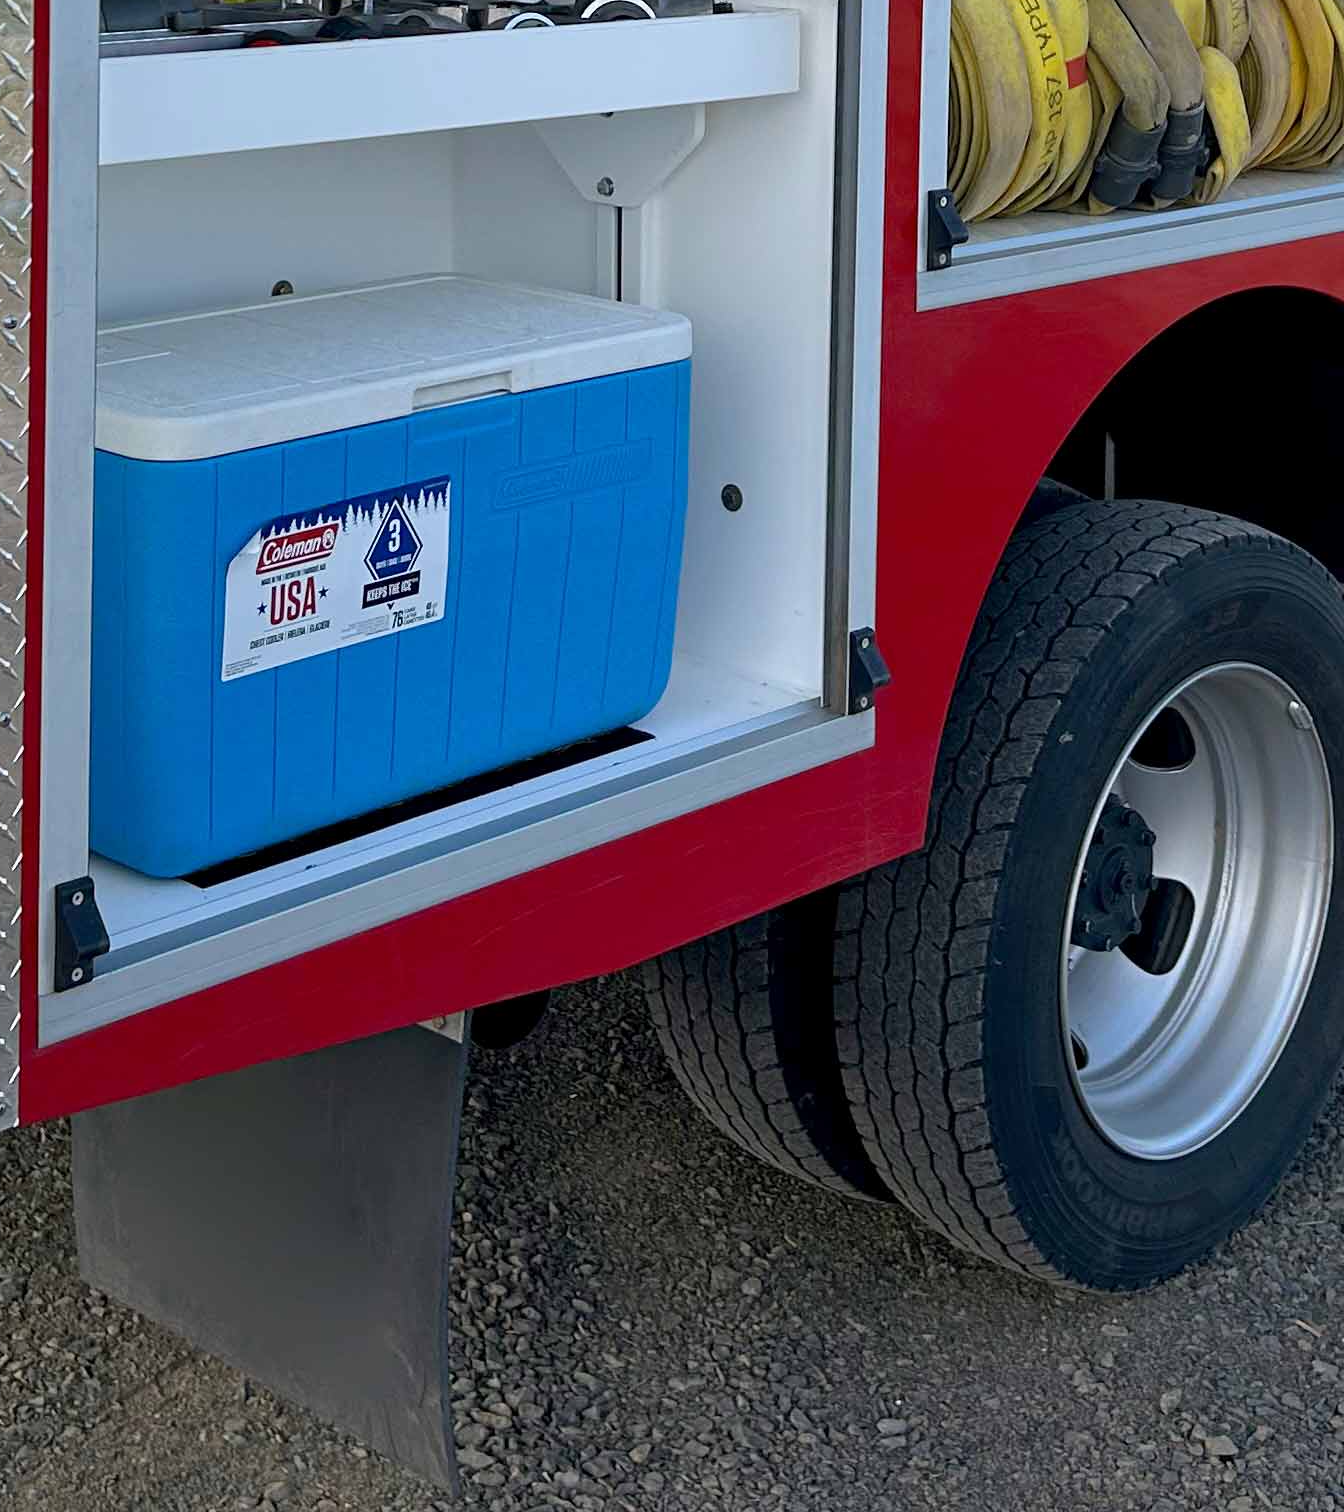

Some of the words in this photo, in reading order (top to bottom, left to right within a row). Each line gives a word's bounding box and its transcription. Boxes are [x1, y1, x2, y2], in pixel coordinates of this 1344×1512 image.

[262, 535, 322, 566] Coleman
[387, 518, 402, 553] 3
[270, 575, 317, 626] USA
[392, 610, 405, 629] 76
